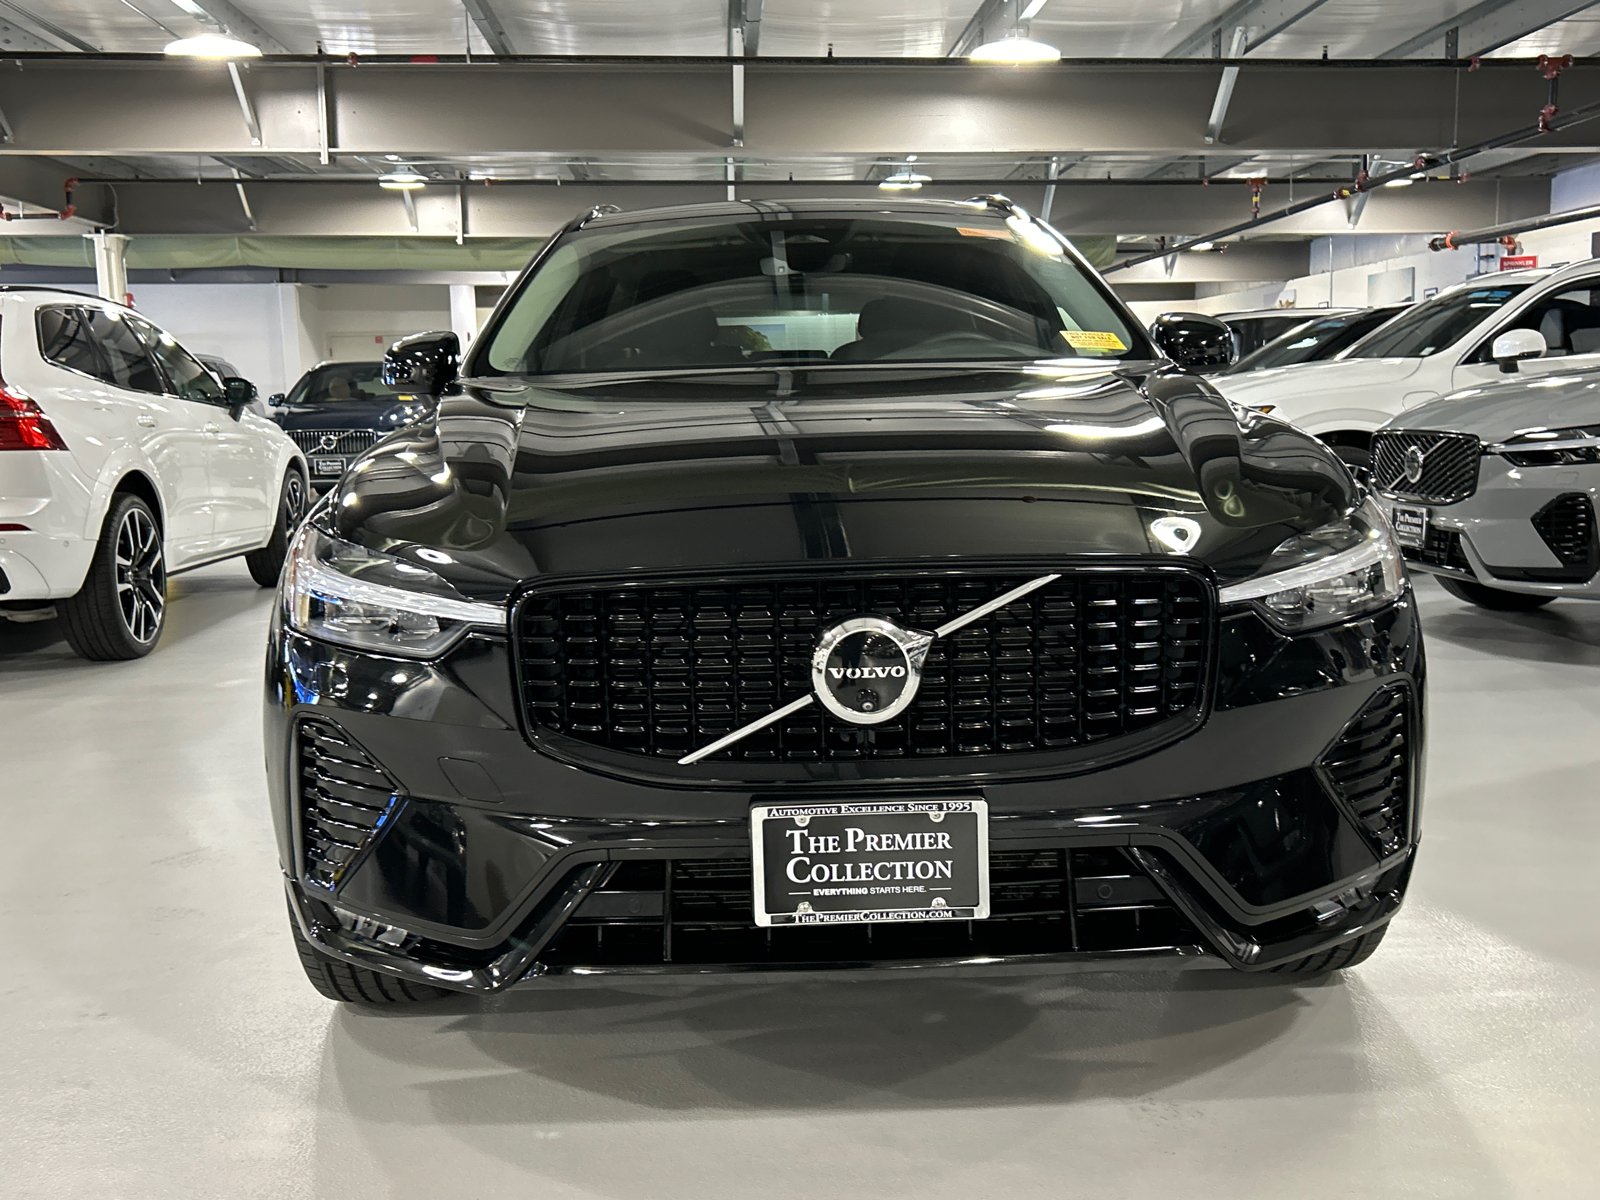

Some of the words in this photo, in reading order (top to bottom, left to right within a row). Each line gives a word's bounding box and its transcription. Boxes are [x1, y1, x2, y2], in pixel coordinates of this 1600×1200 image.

[828, 665, 906, 679] VOLVO
[769, 807, 838, 817] AUTOMOTIVE
[840, 804, 905, 814] EXCELLENCE
[907, 803, 939, 812] SINCE
[942, 802, 971, 811] 1995
[785, 828, 841, 855] THE
[844, 827, 953, 852] PREMIER
[786, 857, 953, 884] COLLECTION
[813, 887, 869, 896] EVERYTHING
[870, 886, 901, 895] STARTS
[902, 885, 928, 893] HERE.
